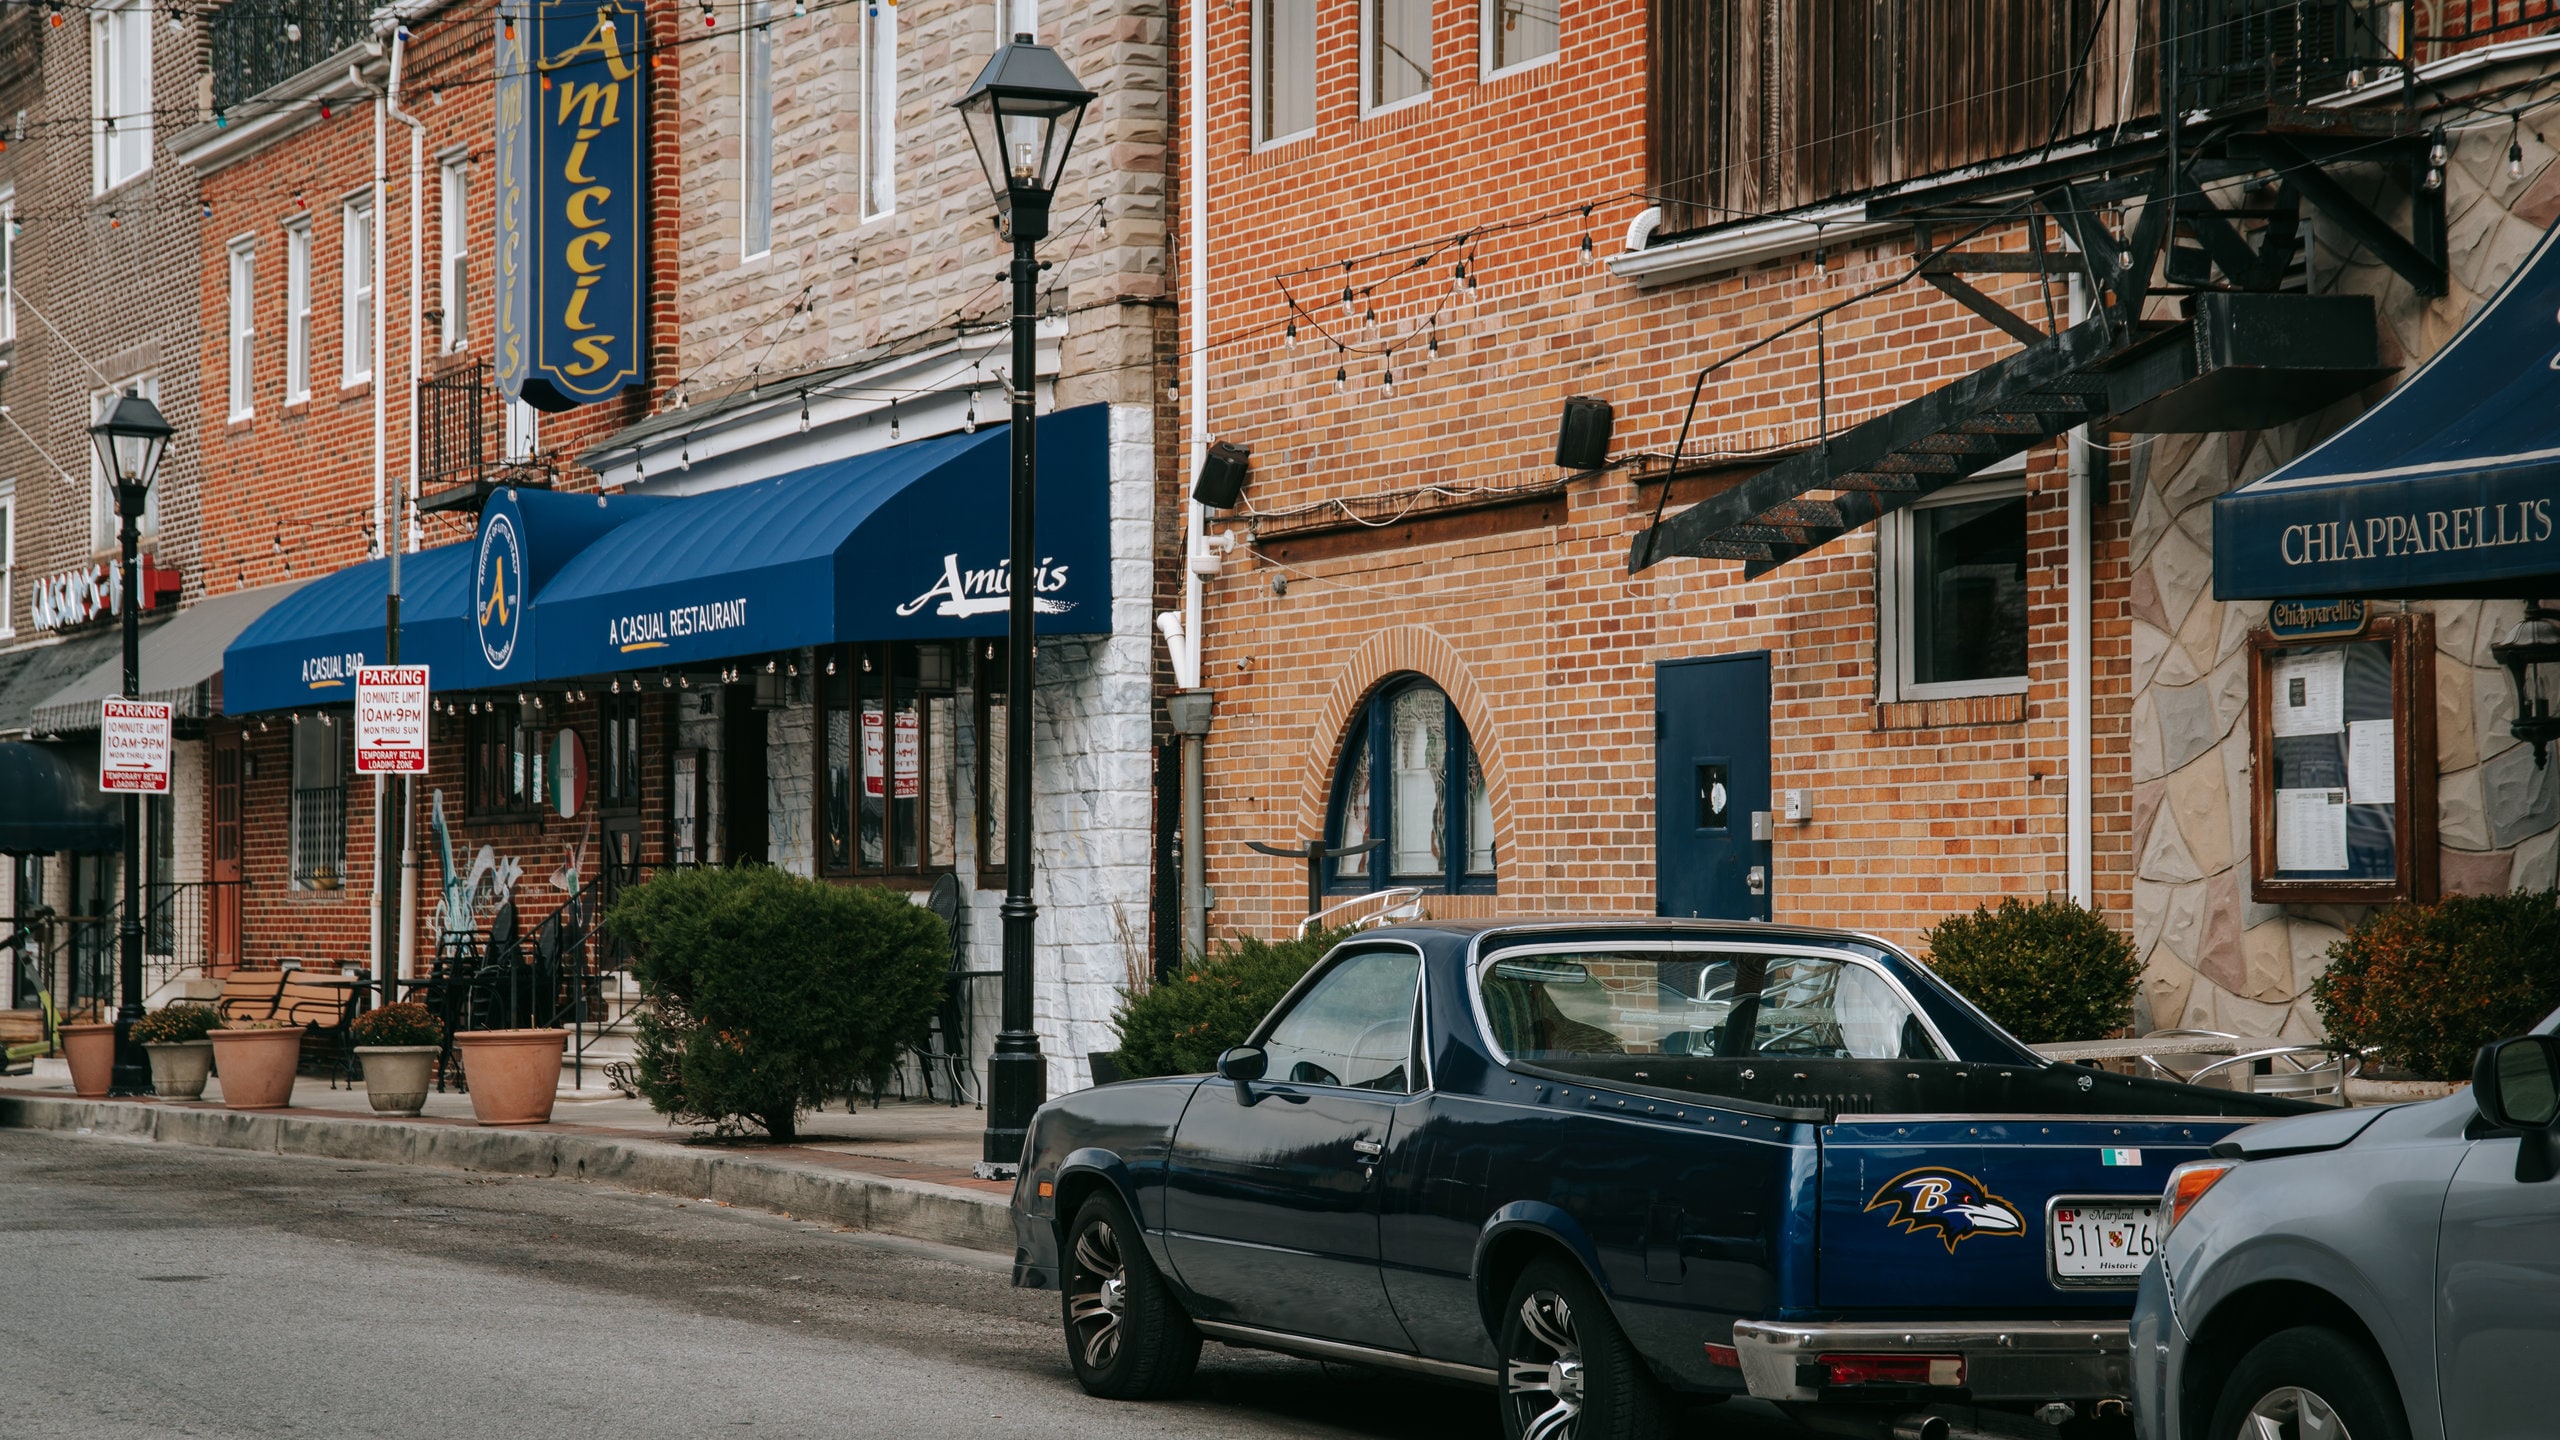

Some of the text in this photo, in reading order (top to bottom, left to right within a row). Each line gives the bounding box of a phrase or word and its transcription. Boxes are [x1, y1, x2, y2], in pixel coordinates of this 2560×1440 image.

[2281, 499, 2552, 566] CHIAPPARELLI'S
[2274, 600, 2361, 628] Chiapparelli's
[609, 598, 747, 645] A CASUAL RESTAURANT
[302, 660, 309, 681] A
[310, 655, 344, 681] CASUAL
[363, 671, 422, 684] PARKING
[363, 692, 420, 703] 10 MINUTE LIMIT
[108, 704, 166, 718] PARKING
[362, 708, 420, 722] 10AM-9PM
[108, 722, 164, 734] 10 MINUTE LIMIT
[364, 727, 419, 735] MON THRU SUN
[107, 736, 164, 749] 10AM-9PM
[361, 751, 421, 760] TEMPORARY RETAIL
[368, 761, 413, 769] LOADING ZONE
[106, 772, 164, 782] TEMPORARY RETAIL
[112, 781, 157, 790] LOADING ZONE
[2089, 1209, 2134, 1223] Maryland
[2060, 1224, 2103, 1257] 511
[2099, 1262, 2139, 1270] Historic
